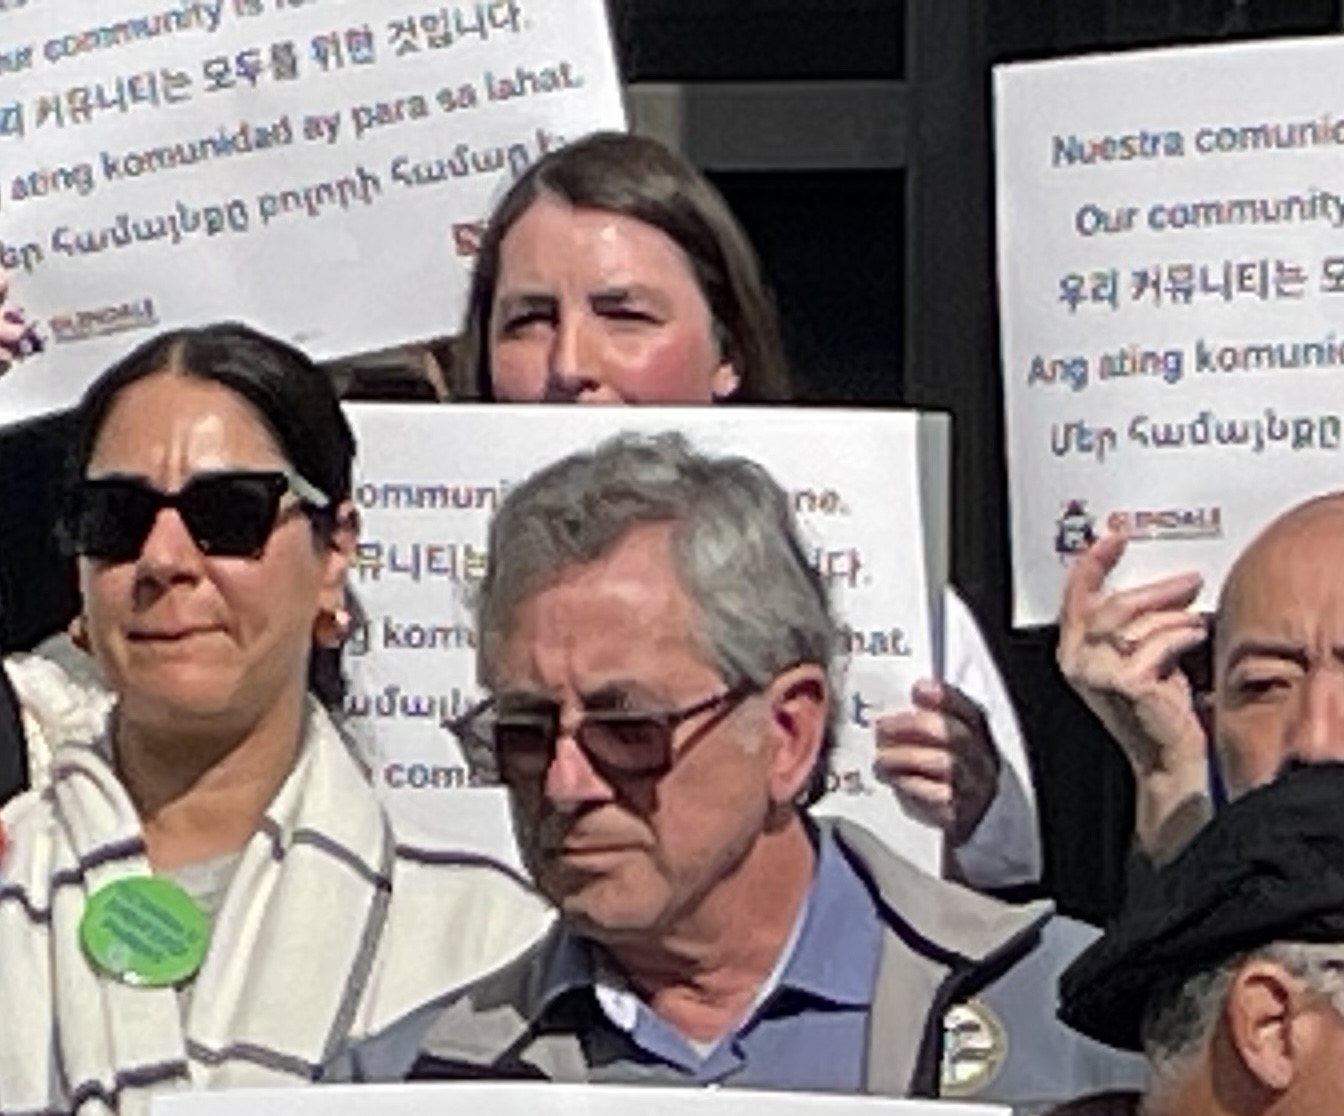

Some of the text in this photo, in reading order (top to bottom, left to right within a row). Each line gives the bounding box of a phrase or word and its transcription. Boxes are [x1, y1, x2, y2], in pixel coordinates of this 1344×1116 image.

[350, 95, 430, 140] para
[1051, 130, 1185, 168] Nuestra
[1075, 203, 1140, 238] Our
[1058, 268, 1120, 314] 우리
[1130, 258, 1309, 307] 커뮤니티는
[1027, 355, 1089, 393] Ang
[1098, 348, 1185, 385] ating
